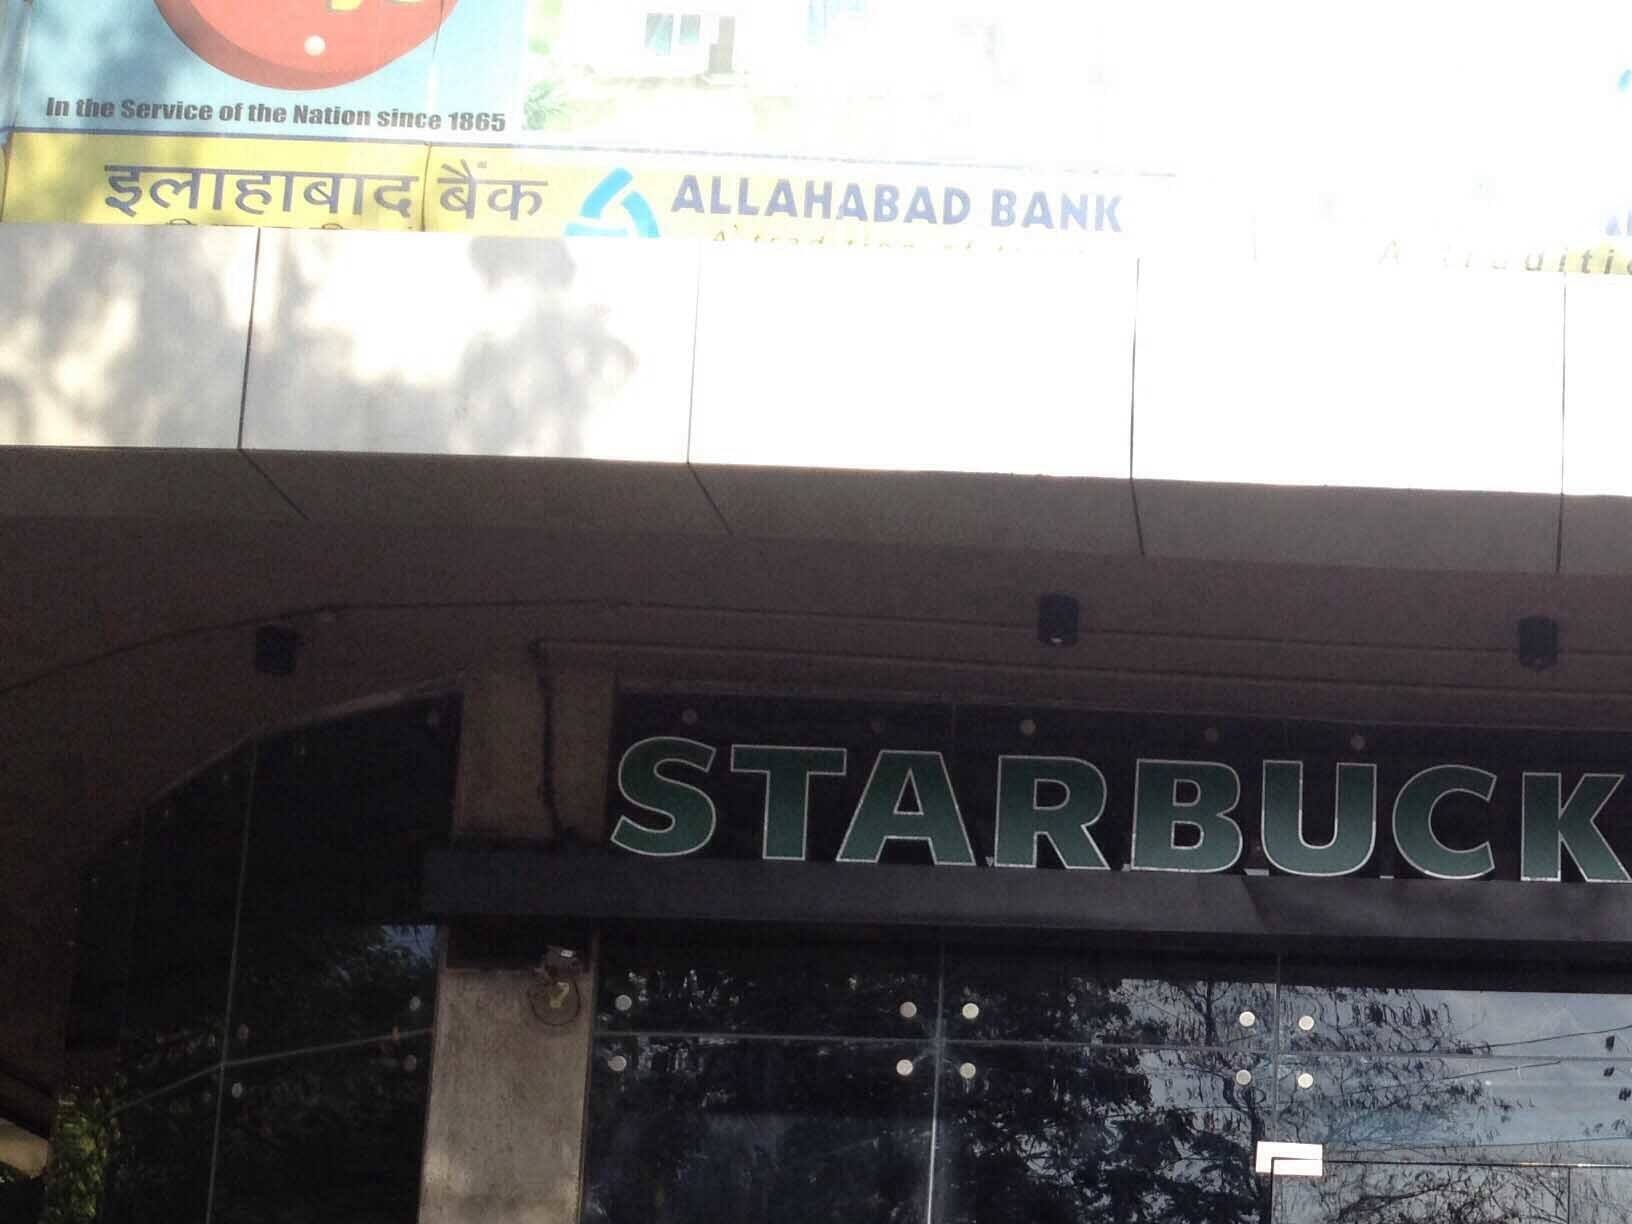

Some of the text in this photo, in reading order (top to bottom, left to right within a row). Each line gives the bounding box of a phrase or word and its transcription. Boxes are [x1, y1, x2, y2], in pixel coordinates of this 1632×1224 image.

[46, 97, 506, 132] In the Service of the Nation since 1865
[104, 157, 549, 221] इलाहाबाद बैंक
[670, 174, 1123, 232] ALLAHABAD BANK
